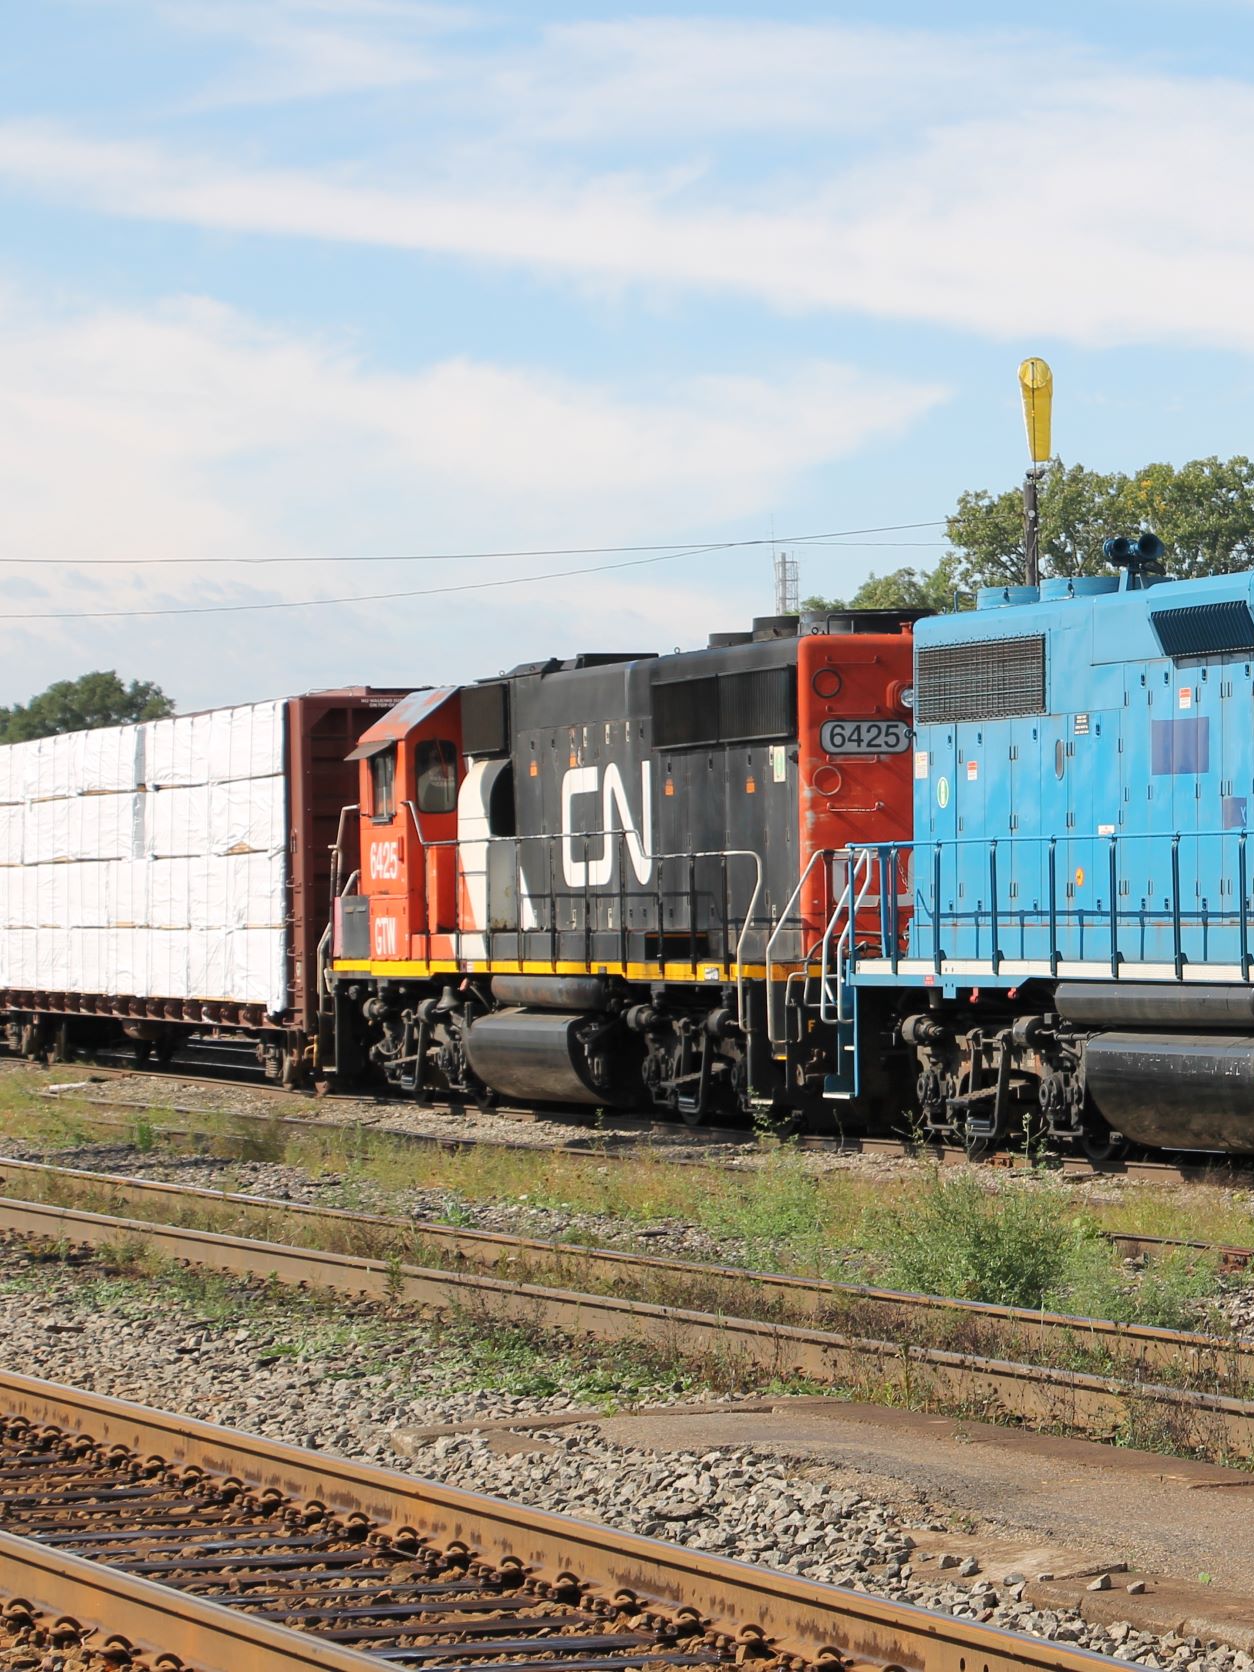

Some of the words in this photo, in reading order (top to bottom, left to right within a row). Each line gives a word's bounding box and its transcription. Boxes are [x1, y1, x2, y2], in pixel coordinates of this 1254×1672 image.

[829, 723, 900, 749] 6425
[562, 760, 652, 887] CN
[370, 841, 398, 880] 6425
[374, 917, 397, 955] GTW
[808, 1019, 816, 1033] F
